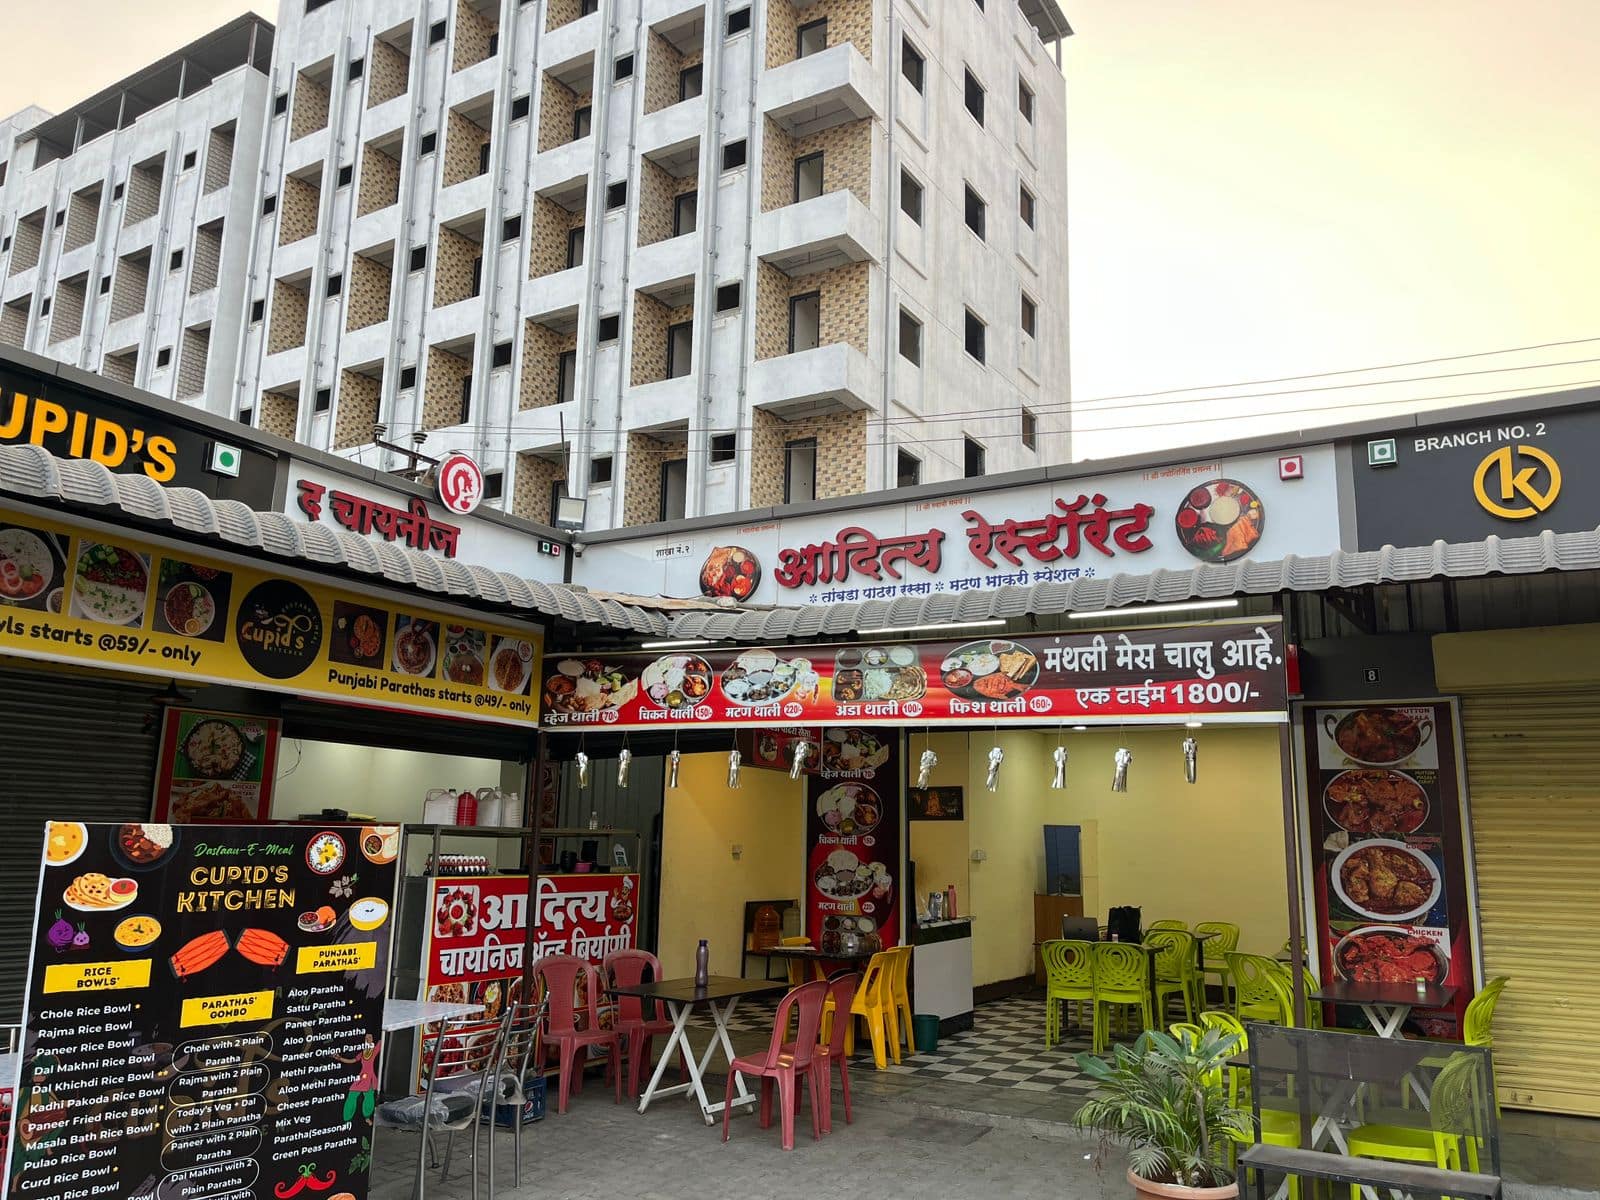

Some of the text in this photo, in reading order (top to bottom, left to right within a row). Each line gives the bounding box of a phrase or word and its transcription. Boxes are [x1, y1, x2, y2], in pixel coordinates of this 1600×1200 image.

[1414, 422, 1546, 453] BRANCH NO. 2
[297, 479, 461, 559] द चायनीज
[774, 493, 1156, 589] आदित्य रेस्टॉरंट
[949, 577, 982, 591] मटण
[986, 569, 1029, 587] भाकरी
[30, 624, 94, 646] starts
[98, 633, 157, 654] @59/-
[161, 644, 201, 666] only
[1044, 634, 1107, 673] मंथली
[1115, 633, 1156, 671] मेस
[1222, 627, 1283, 670] आहे.
[1368, 670, 1376, 681] 8
[328, 669, 531, 715] Punjabi Parathas starts @49/- only
[1075, 679, 1260, 709] एक टाईम 1800/-
[639, 706, 668, 721] चिकन
[670, 705, 694, 720] थाली
[725, 706, 752, 718] मटण
[754, 703, 781, 717] थाली
[835, 700, 861, 716] अंडा
[864, 700, 899, 716] थाली
[949, 698, 986, 715] फिश
[989, 698, 1027, 714] थाली
[544, 709, 568, 726] व्हेज
[571, 708, 600, 723] थाली
[190, 865, 289, 886] CUPID'S
[177, 888, 296, 912] KITCHEN
[479, 878, 609, 930] आदित्य
[1407, 928, 1443, 937] CHICKEN
[319, 948, 358, 958] PUNJABI
[440, 933, 525, 976] चायनिज
[84, 966, 112, 977] RICE
[288, 985, 344, 998] Aloo Paratha
[40, 1003, 131, 1020] Chole Rice Bowl
[286, 1000, 346, 1014] Sattu Paratha
[38, 1021, 132, 1039] Rajma Rice Bowl
[285, 1015, 351, 1030] Paneer Paratha
[183, 1044, 210, 1054] Chole
[212, 1041, 233, 1050] with
[242, 1036, 264, 1046] Plain
[283, 1028, 366, 1046] Aloo Onion Paratha
[36, 1038, 135, 1057] Paneer Rice Bowl
[281, 1051, 313, 1062] Paneer
[315, 1046, 341, 1057] Onion
[34, 1053, 155, 1076] Dal Makhni Rice Bowl
[205, 1055, 241, 1066] Paratha
[280, 1062, 341, 1079] Methi Paratha
[32, 1071, 154, 1095] Dal Khichdi Rice Bowl
[179, 1067, 262, 1086] Rajma with 2 Plain
[278, 1074, 360, 1095] Aloo Methi Paratha
[30, 1087, 165, 1114] Kadhi Pakoda Rice Bowl
[202, 1086, 238, 1098] Paratha
[277, 1092, 345, 1112] Cheese Paratha
[177, 1098, 256, 1118] Today's Veg Dal
[28, 1105, 158, 1132] Paneer Fried Rice Bowl
[170, 1125, 192, 1135] with
[201, 1119, 224, 1129] Plain
[226, 1113, 261, 1125] Paratha
[275, 1115, 311, 1128] Mix Veg
[26, 1123, 153, 1151] Masala Bath Rice Bowl
[23, 1147, 117, 1171] Pulao Rice Bowl
[272, 1137, 357, 1161] Green Peas Paratha
[21, 1166, 110, 1190] Curd Rice Bowl
